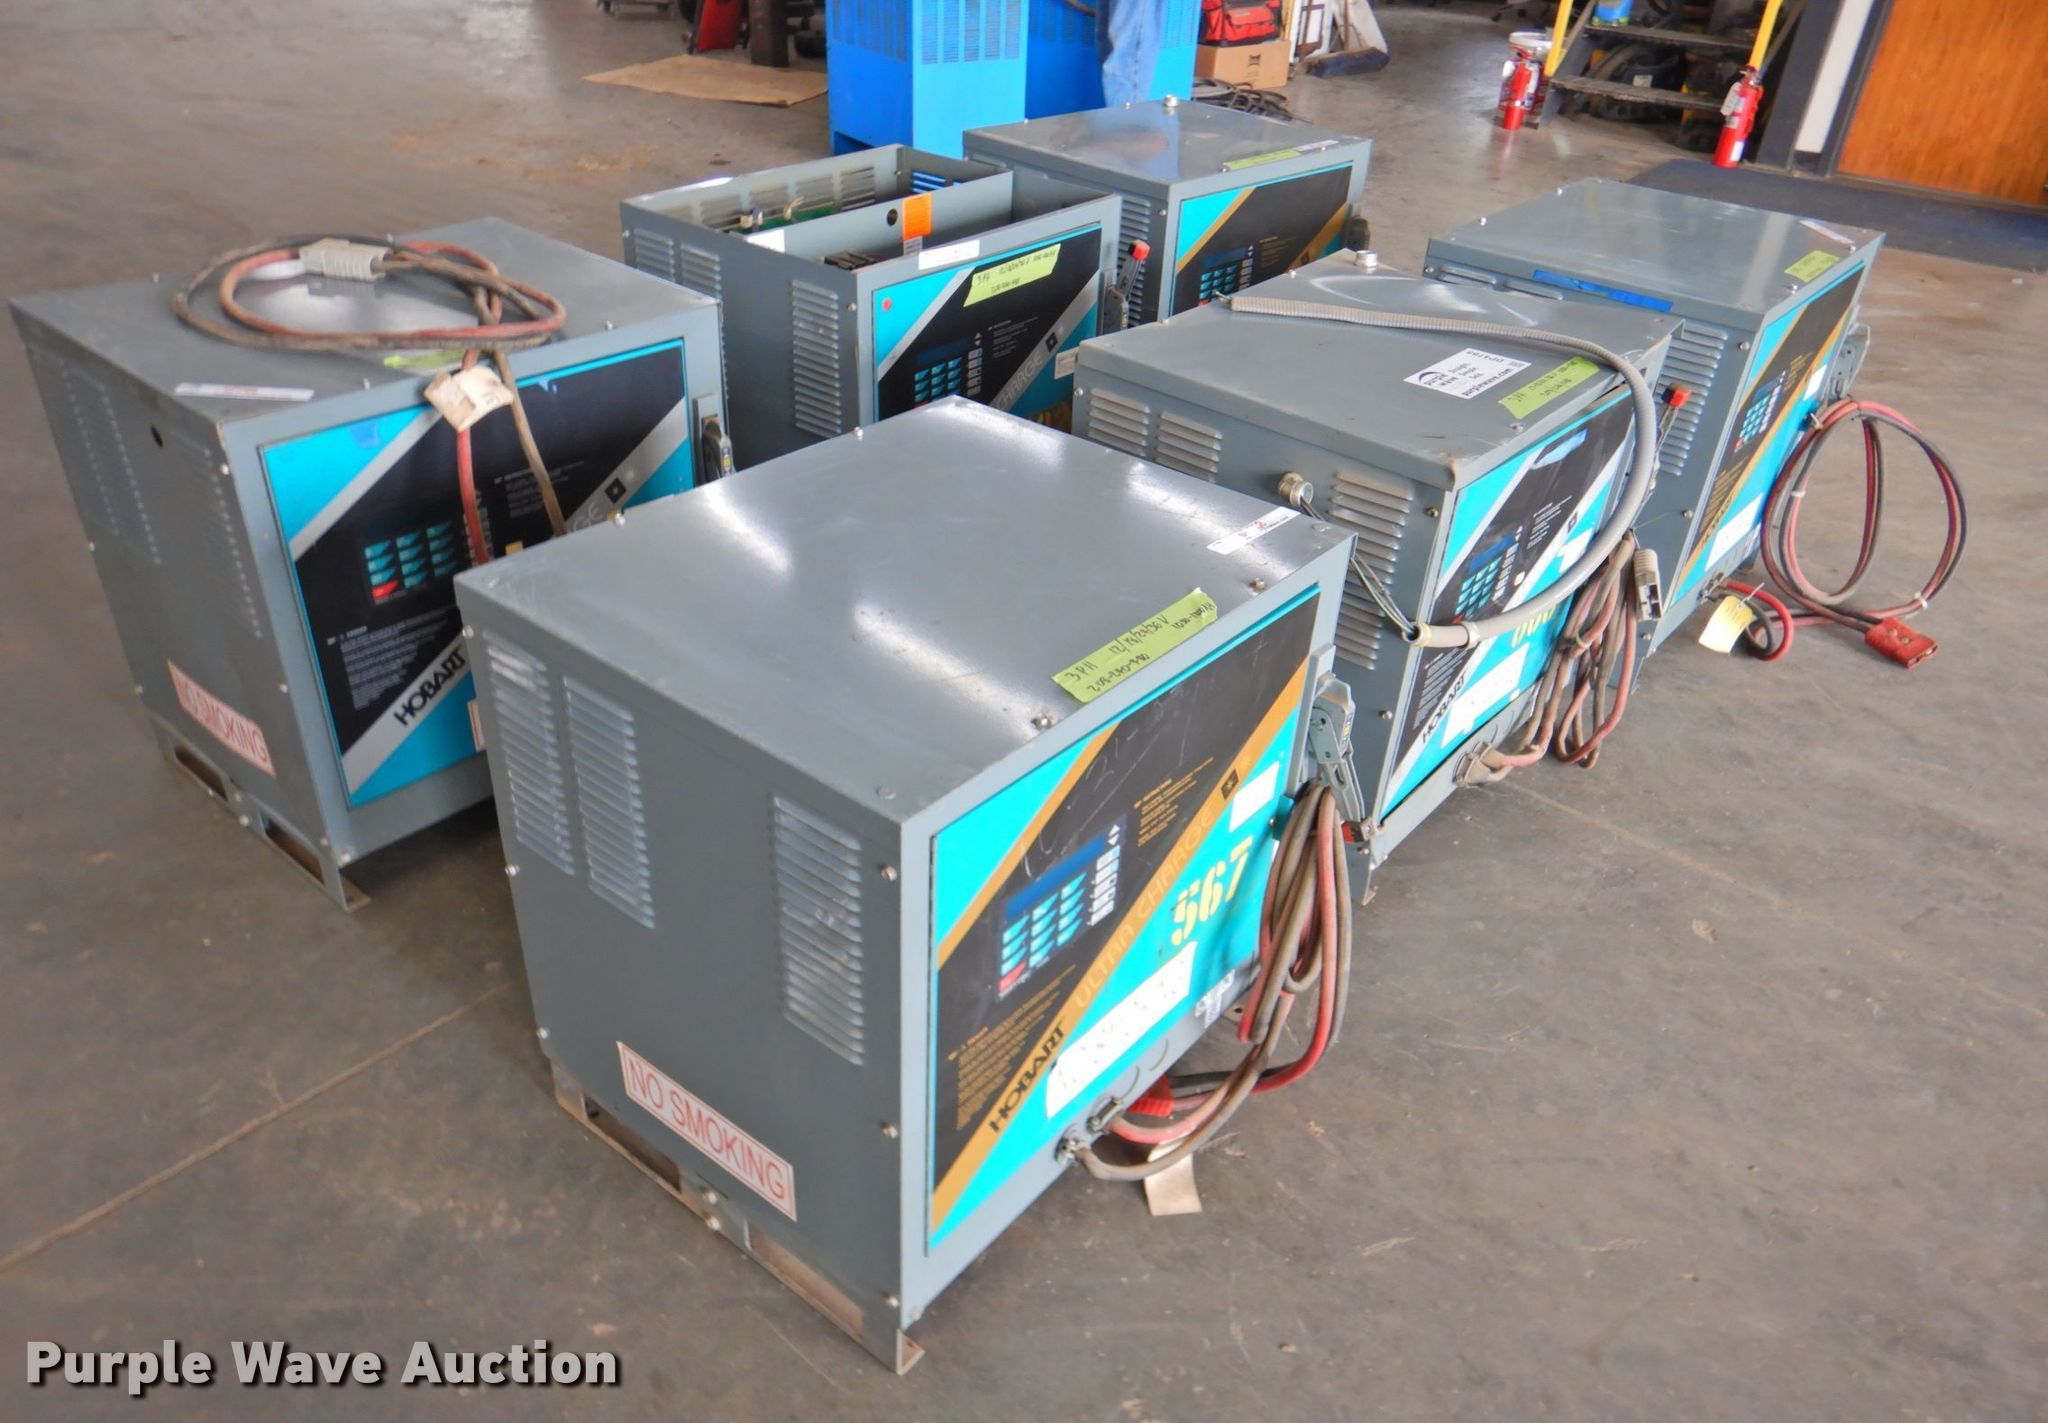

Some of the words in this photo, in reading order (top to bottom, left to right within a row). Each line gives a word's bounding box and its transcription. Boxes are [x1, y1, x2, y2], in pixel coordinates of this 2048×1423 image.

[202, 694, 267, 763] SMOKING
[393, 649, 466, 727] HOBART
[1422, 670, 1466, 744] HOBART
[1171, 835, 1253, 947] 567
[989, 1020, 1064, 1133] HOBART
[1074, 923, 1136, 1008] ULTRA
[1135, 810, 1217, 919] CHARGE
[628, 1058, 664, 1110] NO
[669, 1089, 786, 1200] SMOKING
